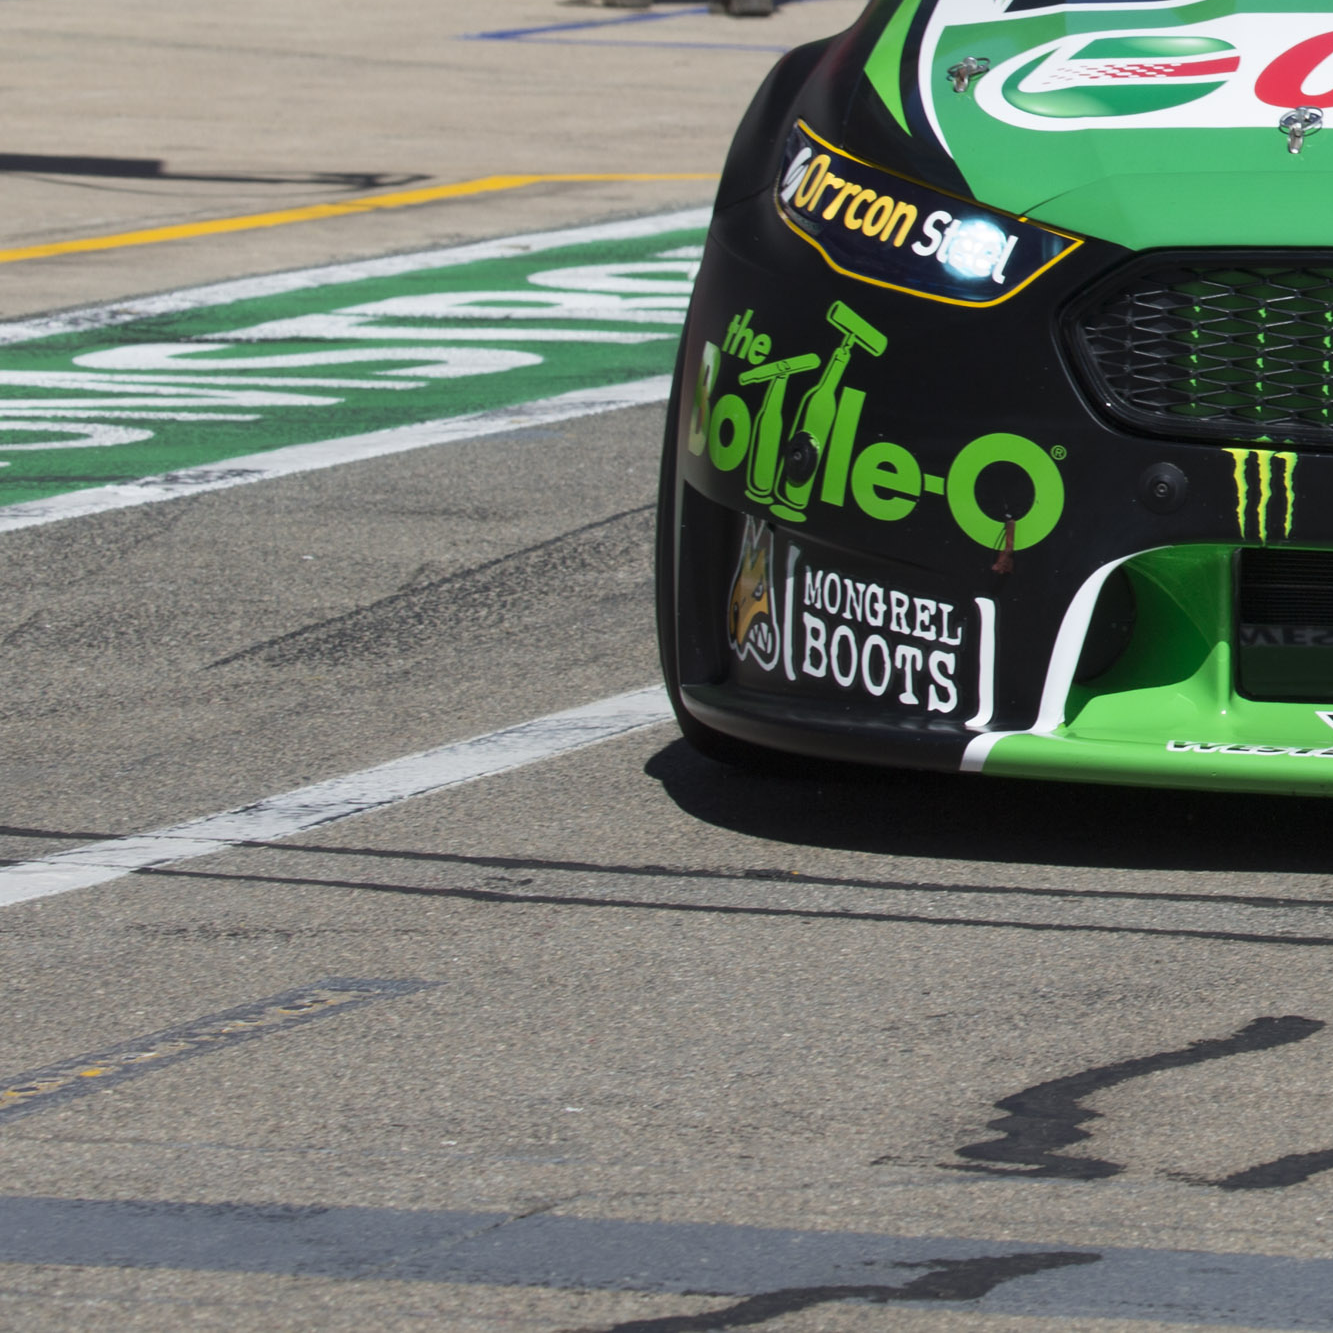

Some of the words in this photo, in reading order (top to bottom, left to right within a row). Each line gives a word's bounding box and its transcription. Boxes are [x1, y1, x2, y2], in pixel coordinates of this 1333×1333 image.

[794, 153, 918, 248] Orrcon
[722, 309, 773, 365] the
[803, 565, 963, 647] MONGREL
[802, 611, 960, 715] BOOTS
